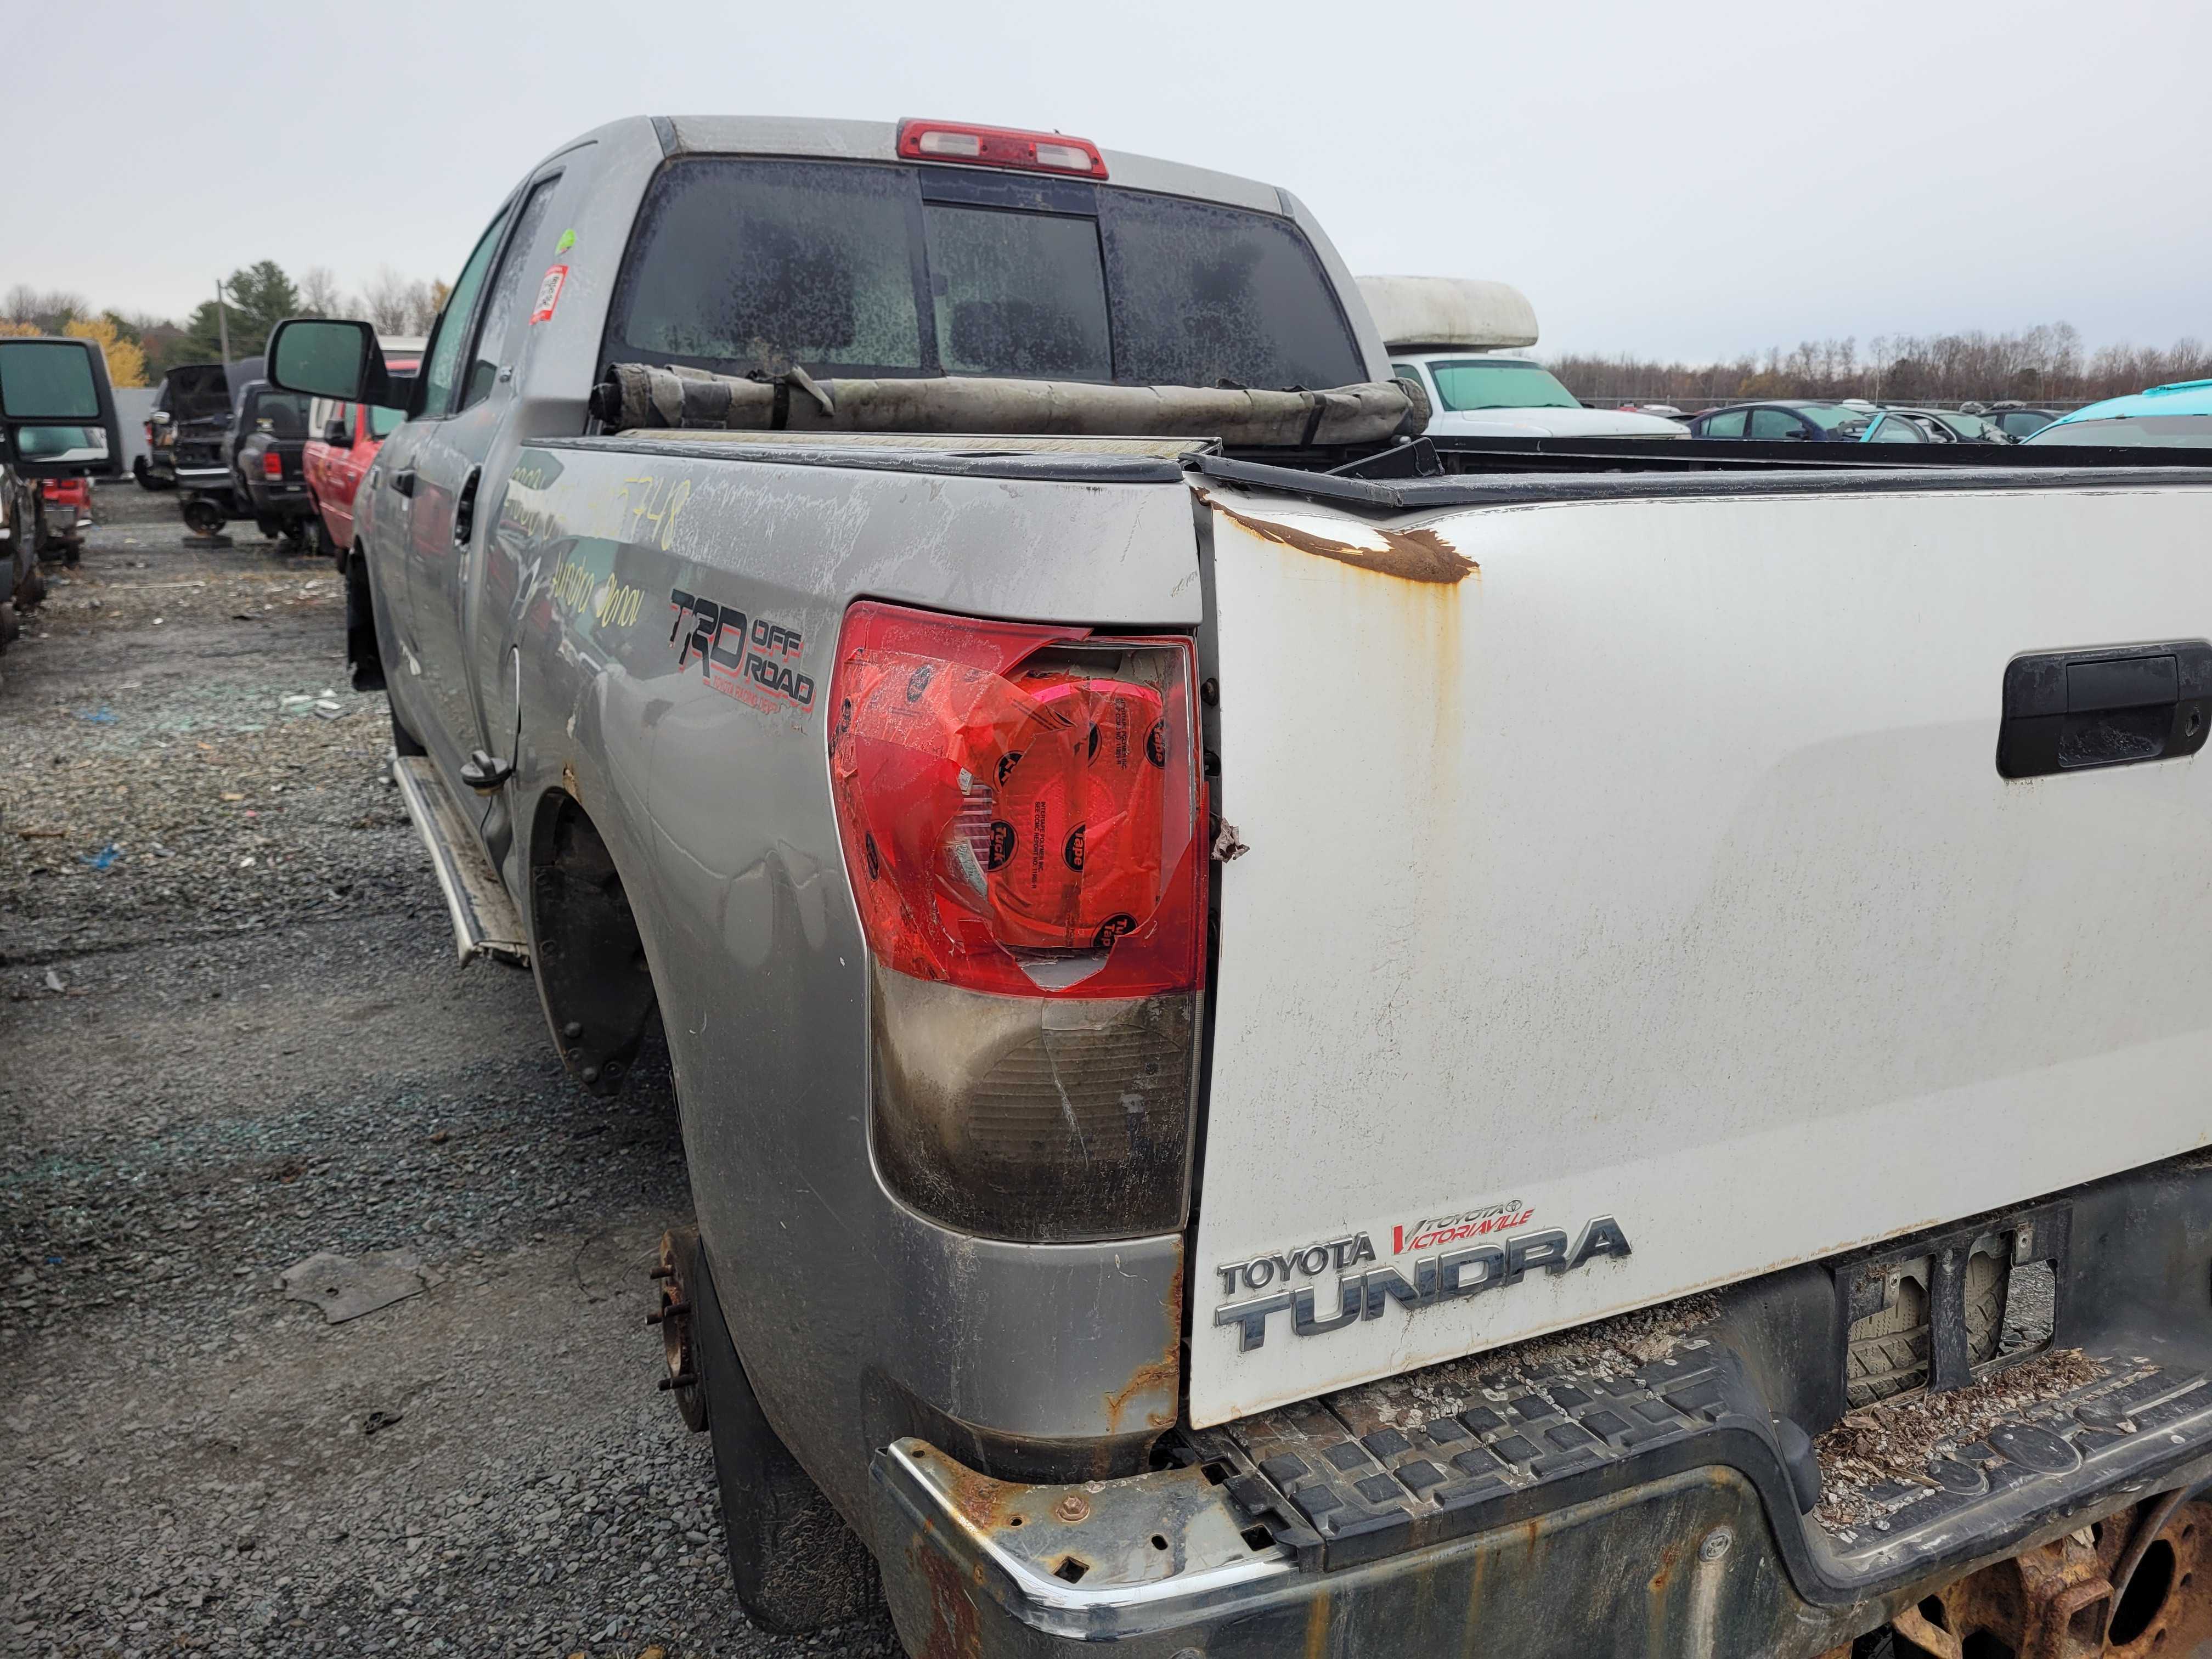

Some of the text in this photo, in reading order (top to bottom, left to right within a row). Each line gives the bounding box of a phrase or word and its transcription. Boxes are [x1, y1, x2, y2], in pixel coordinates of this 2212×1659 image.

[670, 588, 747, 680] TRD
[752, 619, 802, 656] OFF
[744, 653, 815, 705] ROAD
[1154, 727, 1165, 761] Tape
[994, 826, 1007, 862] Tuck
[1073, 832, 1085, 866] Tape
[1102, 923, 1115, 947] Tap
[1392, 1209, 1535, 1255] VICTORIAVILLE
[1426, 1203, 1504, 1232] TOYOTA
[1217, 1231, 1376, 1295] TOYOTA
[1215, 1214, 1633, 1353] TUNDRA
